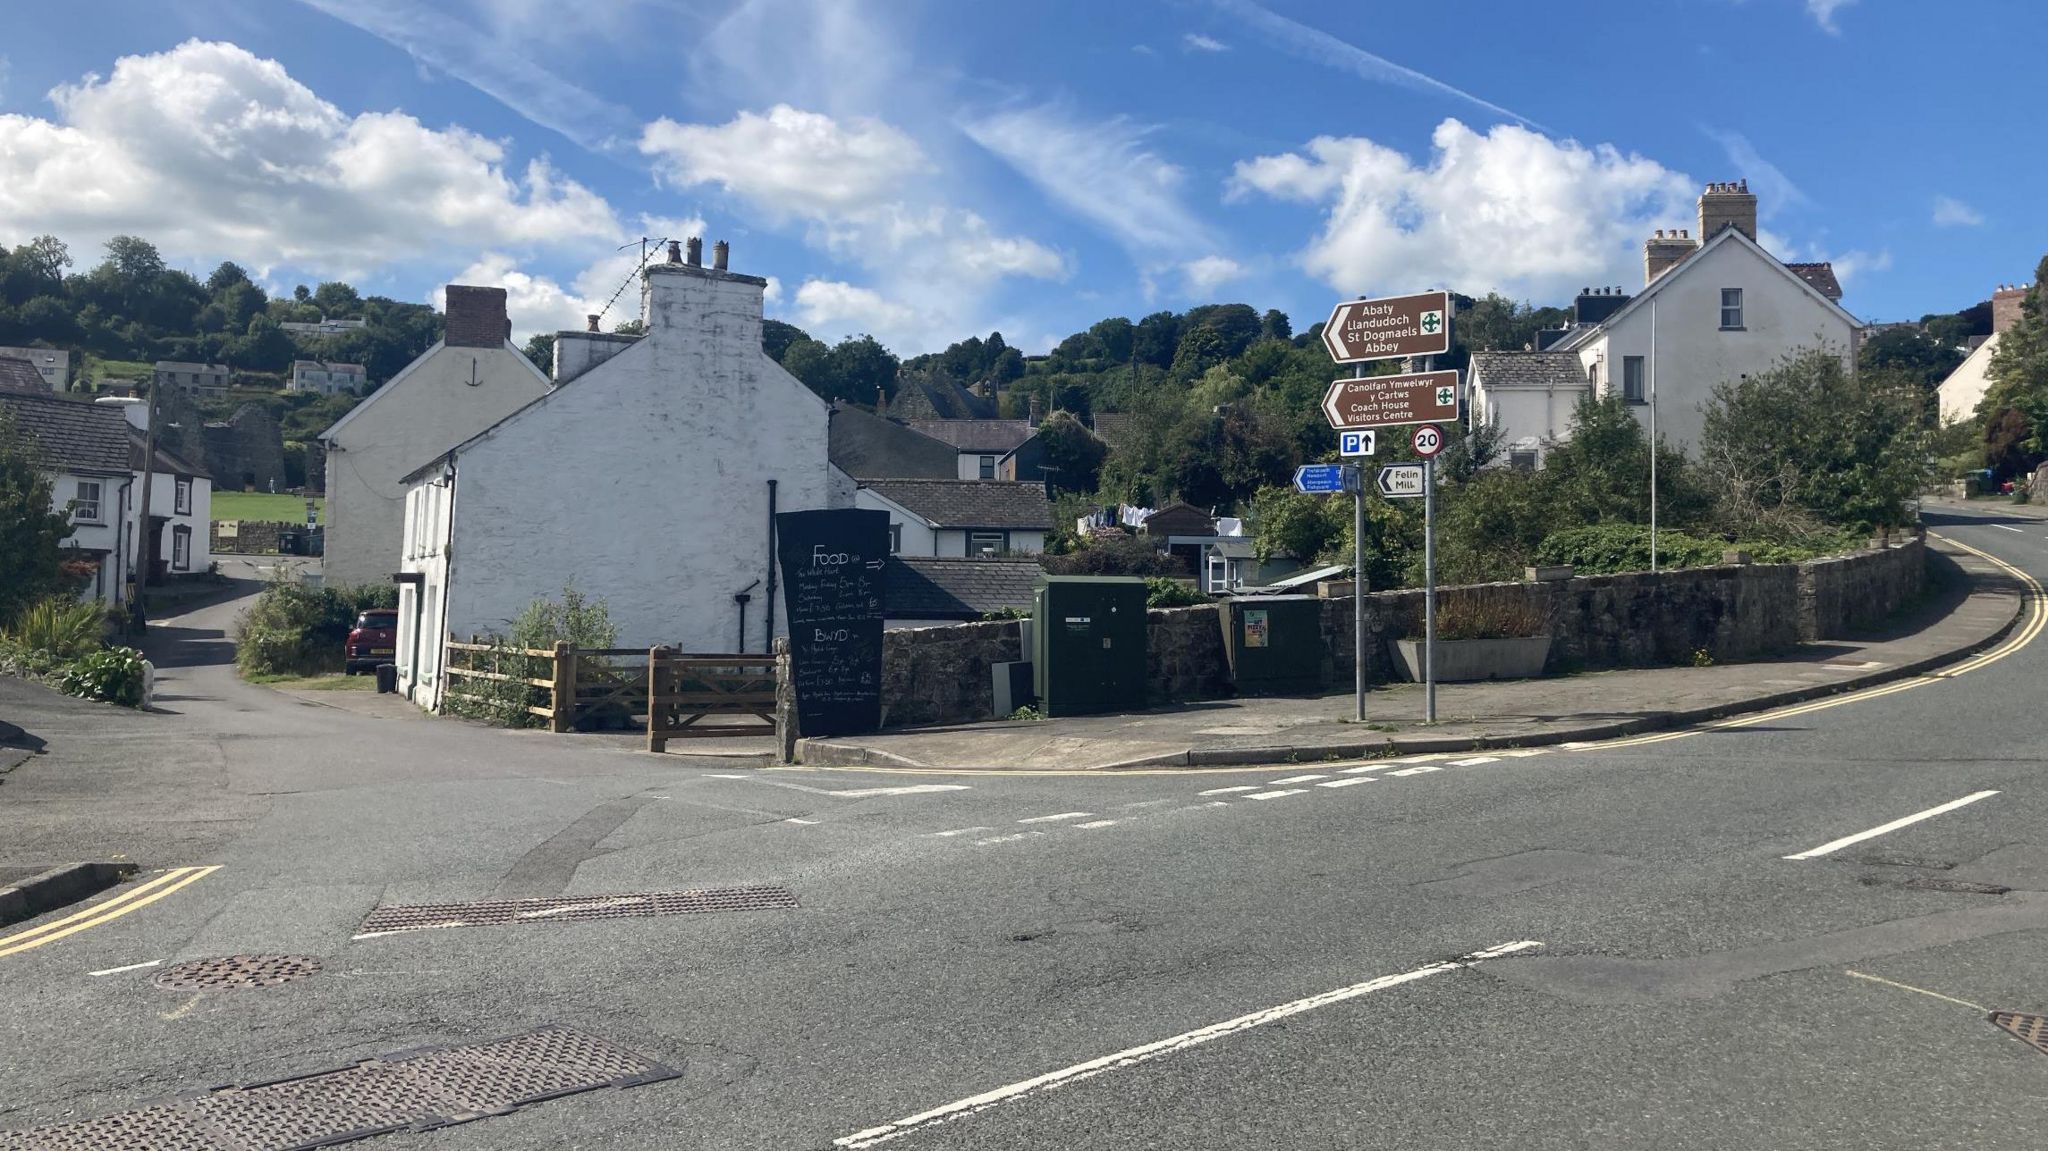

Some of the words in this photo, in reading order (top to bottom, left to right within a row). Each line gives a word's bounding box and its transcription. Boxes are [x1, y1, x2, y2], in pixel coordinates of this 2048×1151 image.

[1362, 304, 1394, 316] Abaty
[1347, 314, 1410, 331] Llandudoch
[1347, 332, 1360, 343] St
[1363, 327, 1418, 342] Dogmaels
[1364, 341, 1399, 353] Abbey
[1347, 382, 1387, 393] Canolfan
[1389, 378, 1434, 391] Ymwelwyr
[1370, 393, 1376, 401] y
[1378, 390, 1410, 400] Cartws
[1351, 402, 1378, 412] Coach
[1381, 401, 1410, 411] House
[1347, 412, 1380, 423] Visitors
[1383, 410, 1413, 420] Centre
[1346, 436, 1358, 451] P
[1417, 433, 1437, 447] 20
[1395, 470, 1419, 479] Felin
[1395, 481, 1415, 489] Mill
